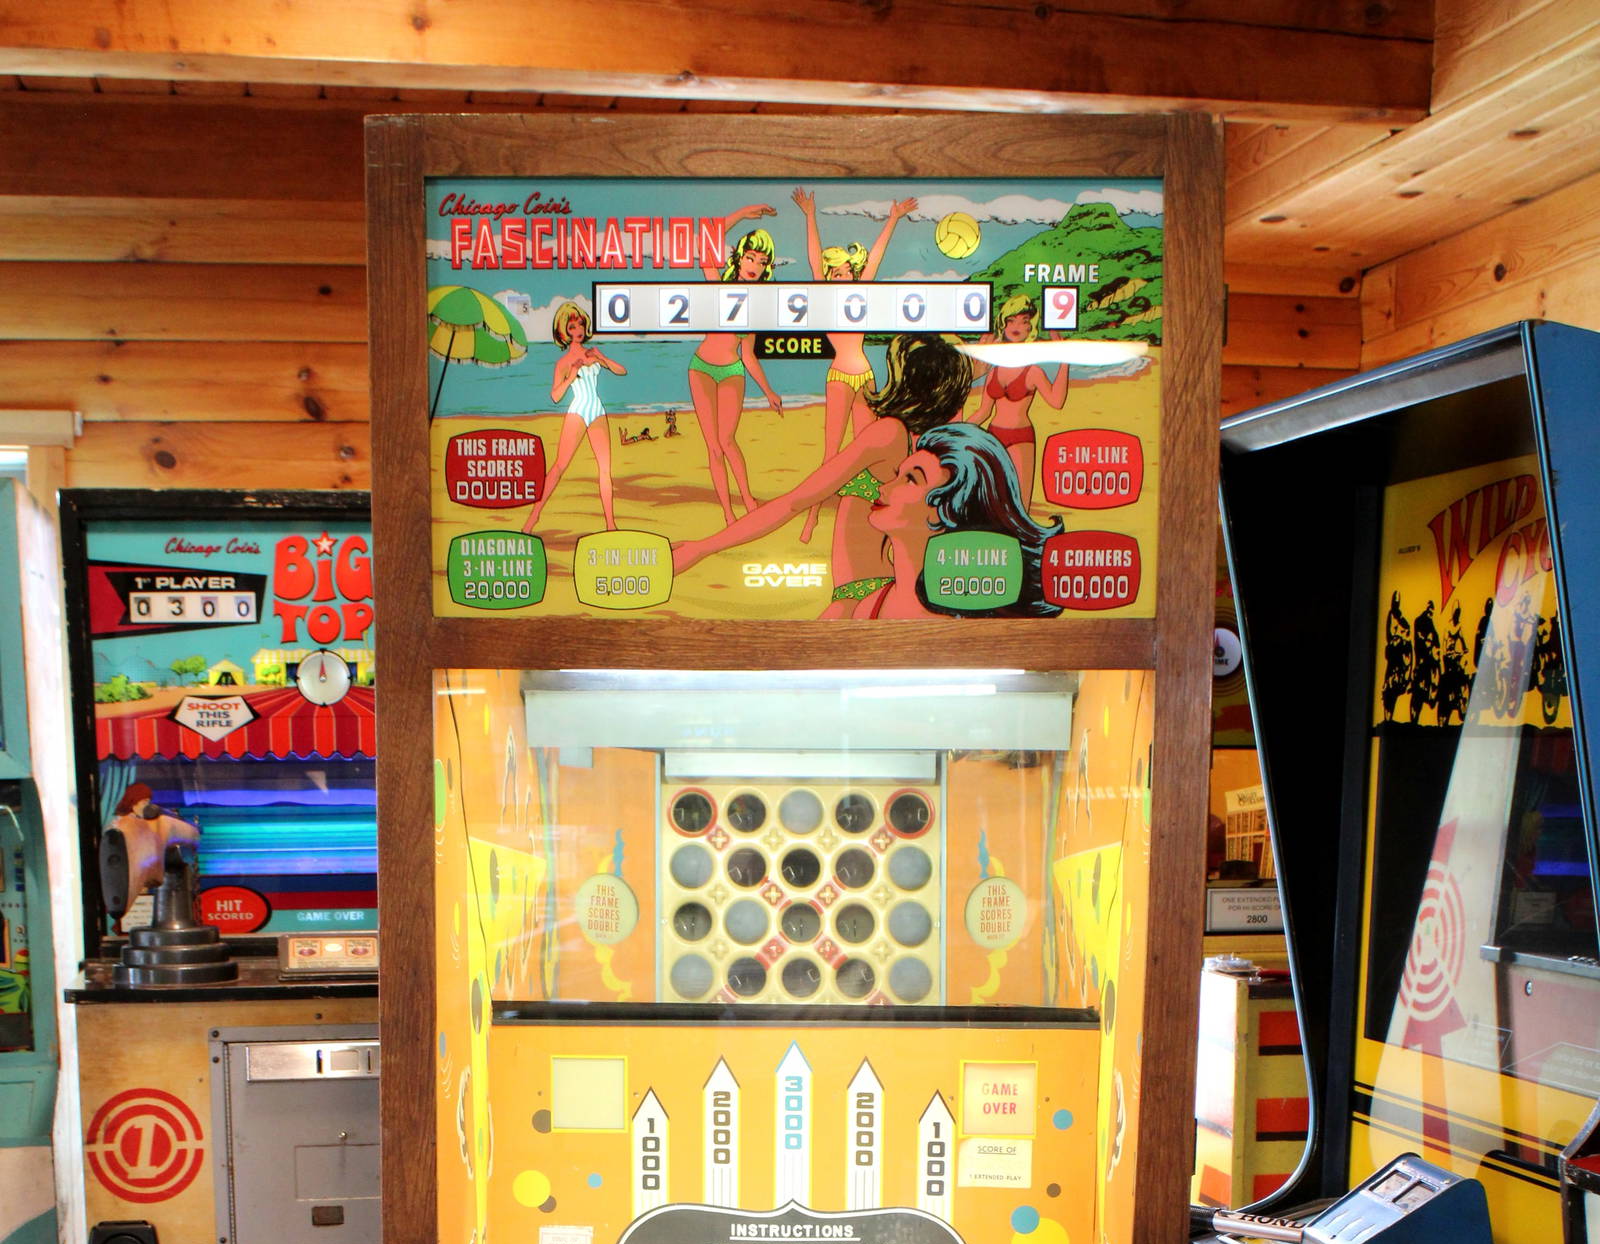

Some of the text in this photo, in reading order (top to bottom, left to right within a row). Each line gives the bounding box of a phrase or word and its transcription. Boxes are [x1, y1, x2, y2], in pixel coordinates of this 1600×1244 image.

[438, 191, 572, 220] Chicago Coin's
[451, 216, 727, 269] FASCINATION
[1024, 263, 1100, 283] FRAME
[1051, 290, 1075, 320] 9
[764, 337, 822, 354] SCORE
[456, 438, 536, 457] THIS FRAME
[467, 459, 524, 478] SCORES
[456, 480, 536, 500] DOUBLE
[1053, 470, 1131, 497] 100,000
[460, 538, 534, 557] DIAGONAL
[1427, 474, 1538, 614] WILD
[1049, 549, 1133, 568] 4 CORNERS
[742, 563, 828, 575] GAME
[155, 576, 236, 590] PLAYER
[595, 576, 651, 596] 5,000
[743, 575, 823, 588] OVER
[939, 576, 1007, 596] 20,000
[1052, 575, 1129, 600] 100,000
[464, 580, 531, 601] 20,000
[272, 599, 375, 645] TOP
[186, 702, 241, 711] SHOOT
[197, 711, 230, 719] THIS
[195, 720, 233, 728] RIFLE
[596, 885, 616, 897] THIS
[987, 884, 1007, 897] THIS
[215, 899, 243, 912] HIT
[590, 896, 620, 909] FRAME
[982, 896, 1011, 908] FRAME
[207, 912, 255, 921] SCORED
[297, 911, 365, 922] GAME OVER
[588, 907, 621, 921] SCORES
[980, 908, 1012, 921] SCORES
[1247, 914, 1268, 924] 2800
[587, 919, 620, 933] DOUBLE
[980, 921, 1011, 933] DOUBLE
[981, 1083, 1019, 1097] GAME
[784, 1075, 803, 1150] 3000
[982, 1102, 1018, 1116] OVER
[712, 1091, 731, 1165] 2000
[855, 1092, 875, 1167] 2000
[641, 1117, 661, 1191] 1000
[977, 1145, 1017, 1155] SCORE OF
[926, 1121, 946, 1197] 1000
[730, 1223, 854, 1238] INSTRUCTIONS
